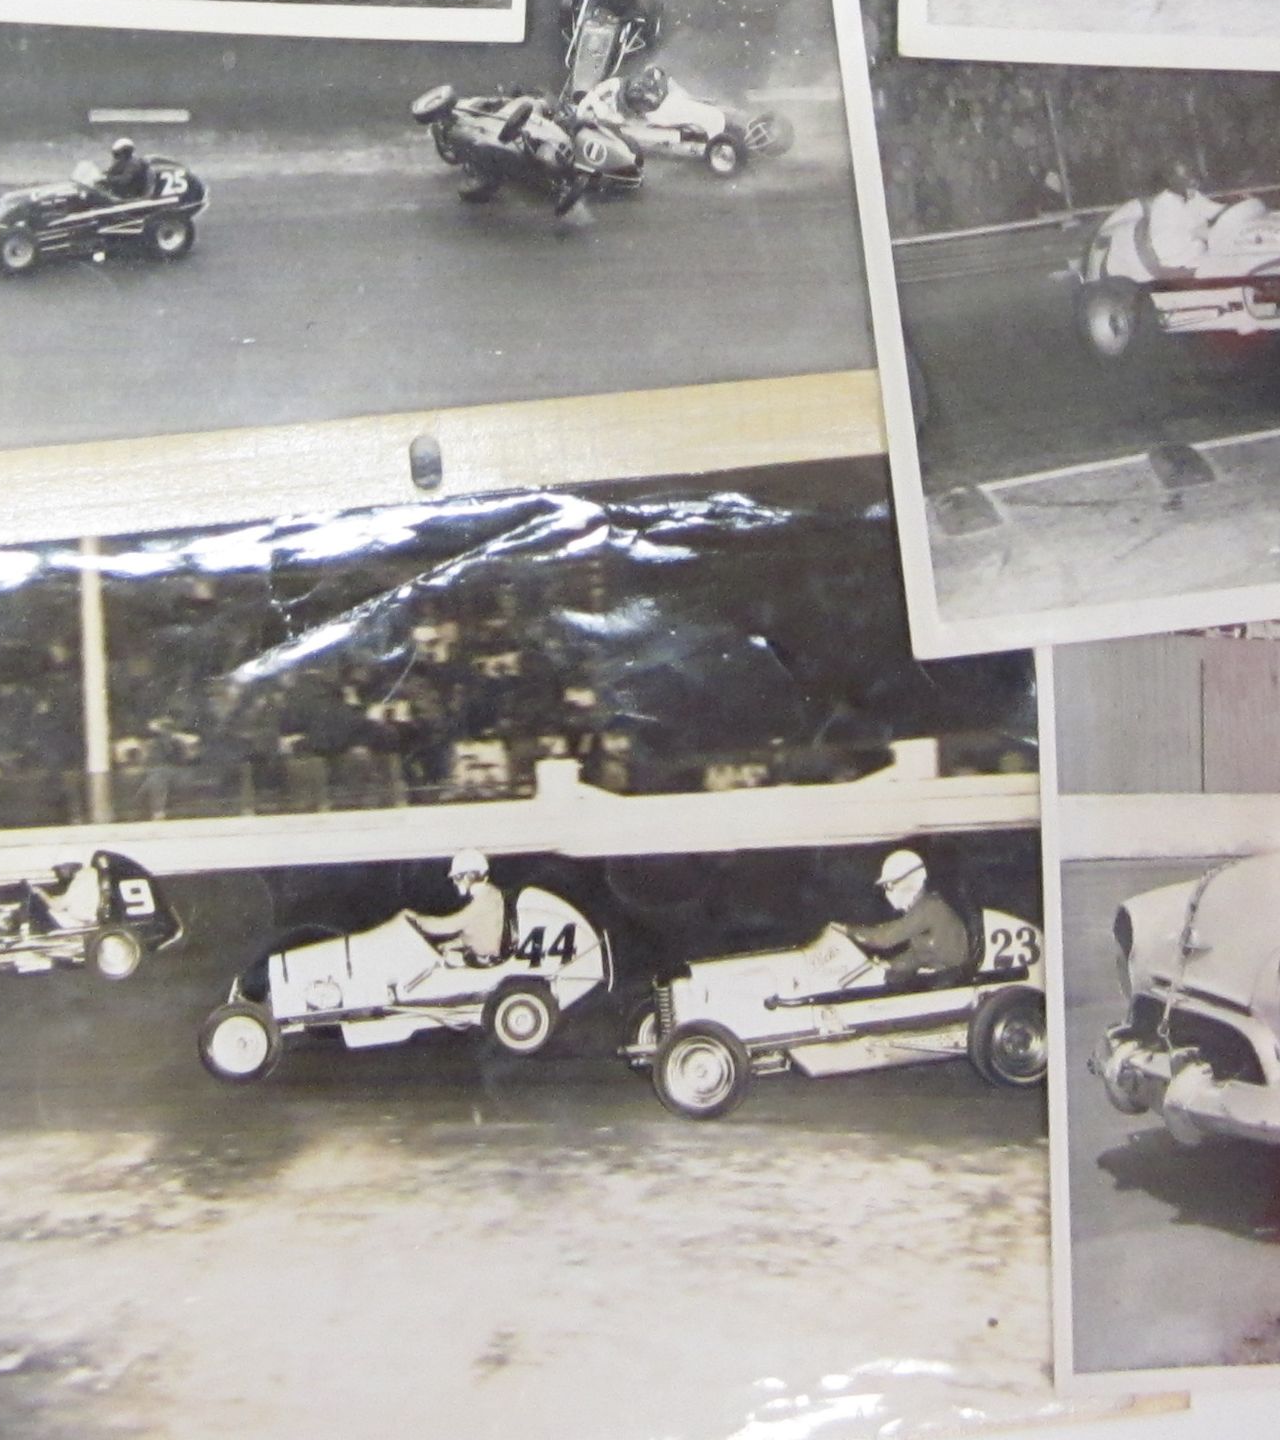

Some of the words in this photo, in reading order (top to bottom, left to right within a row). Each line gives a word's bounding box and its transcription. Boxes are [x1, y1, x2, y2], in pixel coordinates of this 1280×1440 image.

[160, 168, 188, 197] 25
[119, 878, 156, 917] 9
[517, 921, 579, 968] 44
[991, 925, 1042, 970] 23
